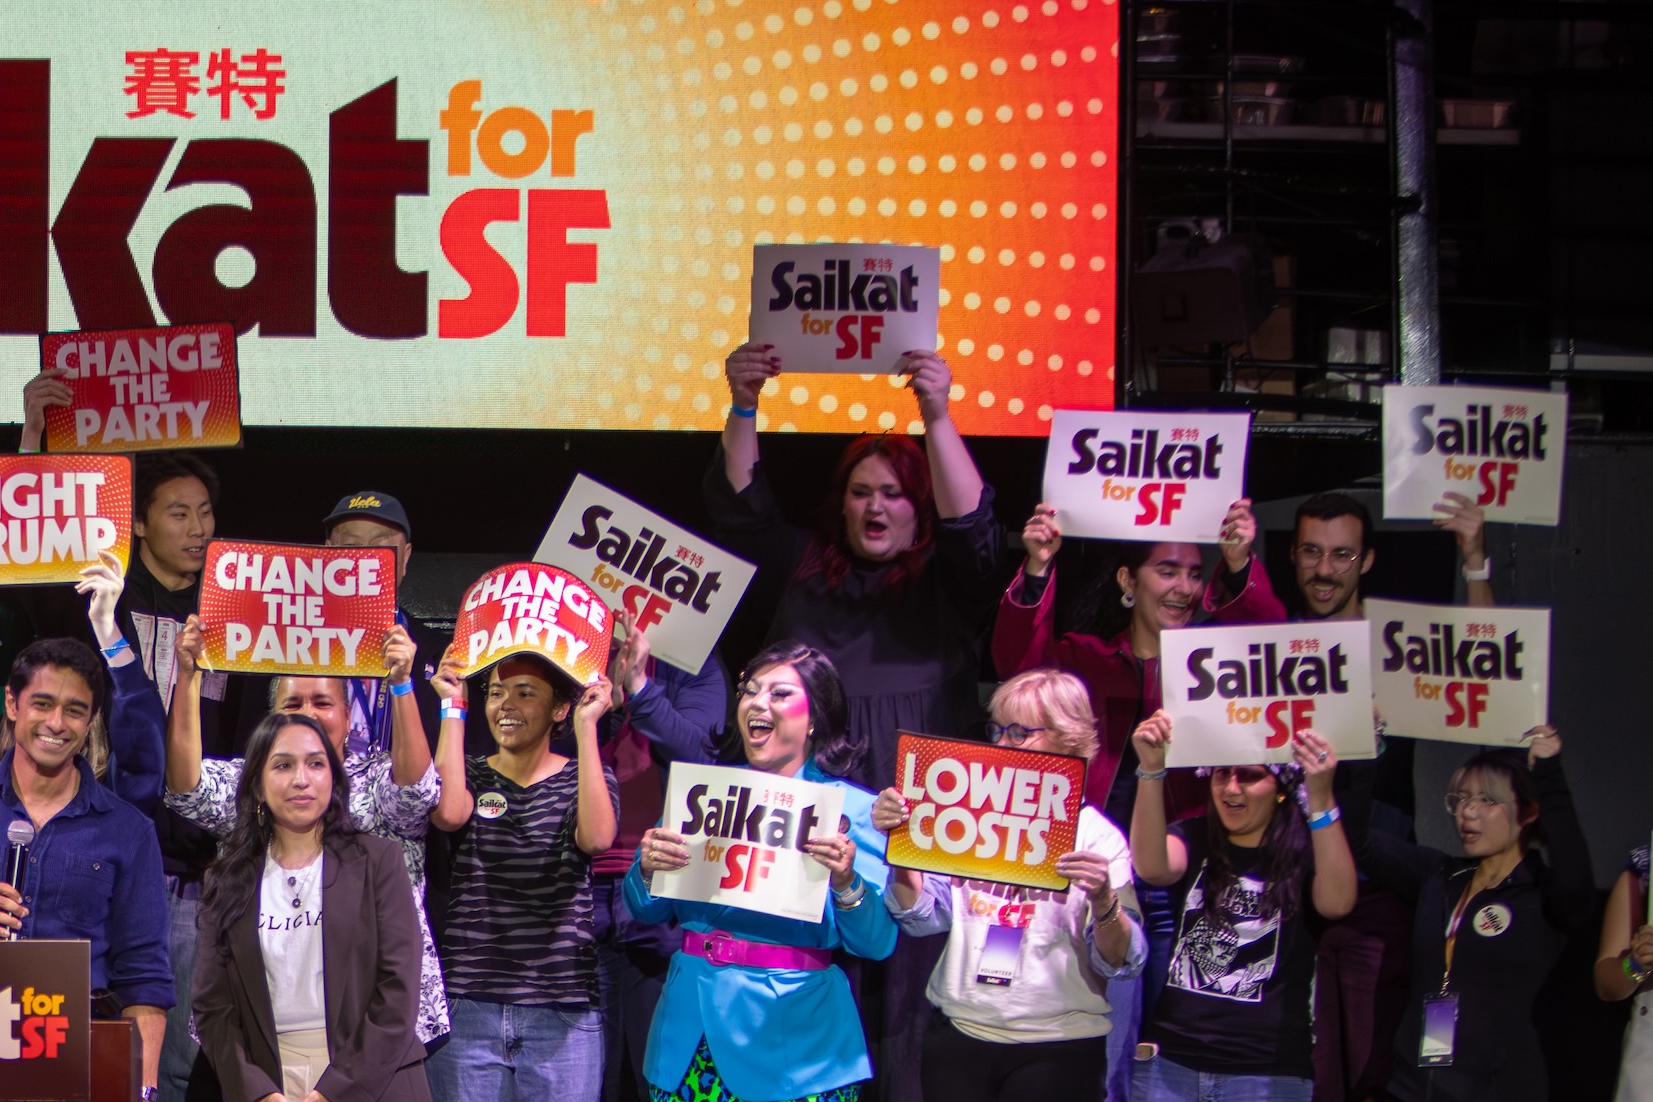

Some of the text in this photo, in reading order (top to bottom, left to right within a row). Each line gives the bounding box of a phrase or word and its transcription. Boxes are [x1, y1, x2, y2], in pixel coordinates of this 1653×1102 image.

[123, 48, 286, 121] 賽特
[439, 80, 594, 180] for
[438, 189, 611, 339] SF
[769, 260, 919, 313] Saikat
[863, 258, 893, 272] 賽特
[55, 332, 223, 379] CHANGE
[801, 314, 885, 360] for SF
[109, 373, 171, 403] THE
[1502, 404, 1528, 420] 賽特
[76, 401, 209, 447] PARTY
[1170, 428, 1199, 442] 賽特
[1411, 403, 1548, 461] Saikat
[1067, 428, 1223, 480] Saikat
[1101, 479, 1186, 527] for SF
[1444, 457, 1520, 507] for SF
[216, 552, 382, 596] CHANGE
[569, 504, 722, 614] Saikat
[674, 545, 705, 568] 賽特
[262, 594, 325, 626] THE
[464, 574, 608, 634] CHANGE
[501, 595, 558, 623] THE
[590, 563, 673, 633] for SF
[225, 622, 366, 668] PARTY
[469, 617, 590, 668] PARTY
[1289, 639, 1321, 654] 賽特
[1382, 621, 1524, 681] Saikat
[1465, 622, 1497, 638] 賽特
[1186, 641, 1349, 701] Saikat
[1226, 700, 1316, 750] for SF
[1414, 675, 1490, 729] for SF
[903, 752, 1072, 822] LOWER
[681, 784, 818, 852] Saikat
[909, 803, 1051, 866] COSTS
[704, 840, 775, 894] for SF
[22, 986, 64, 1015] for
[22, 1016, 69, 1059] SF
